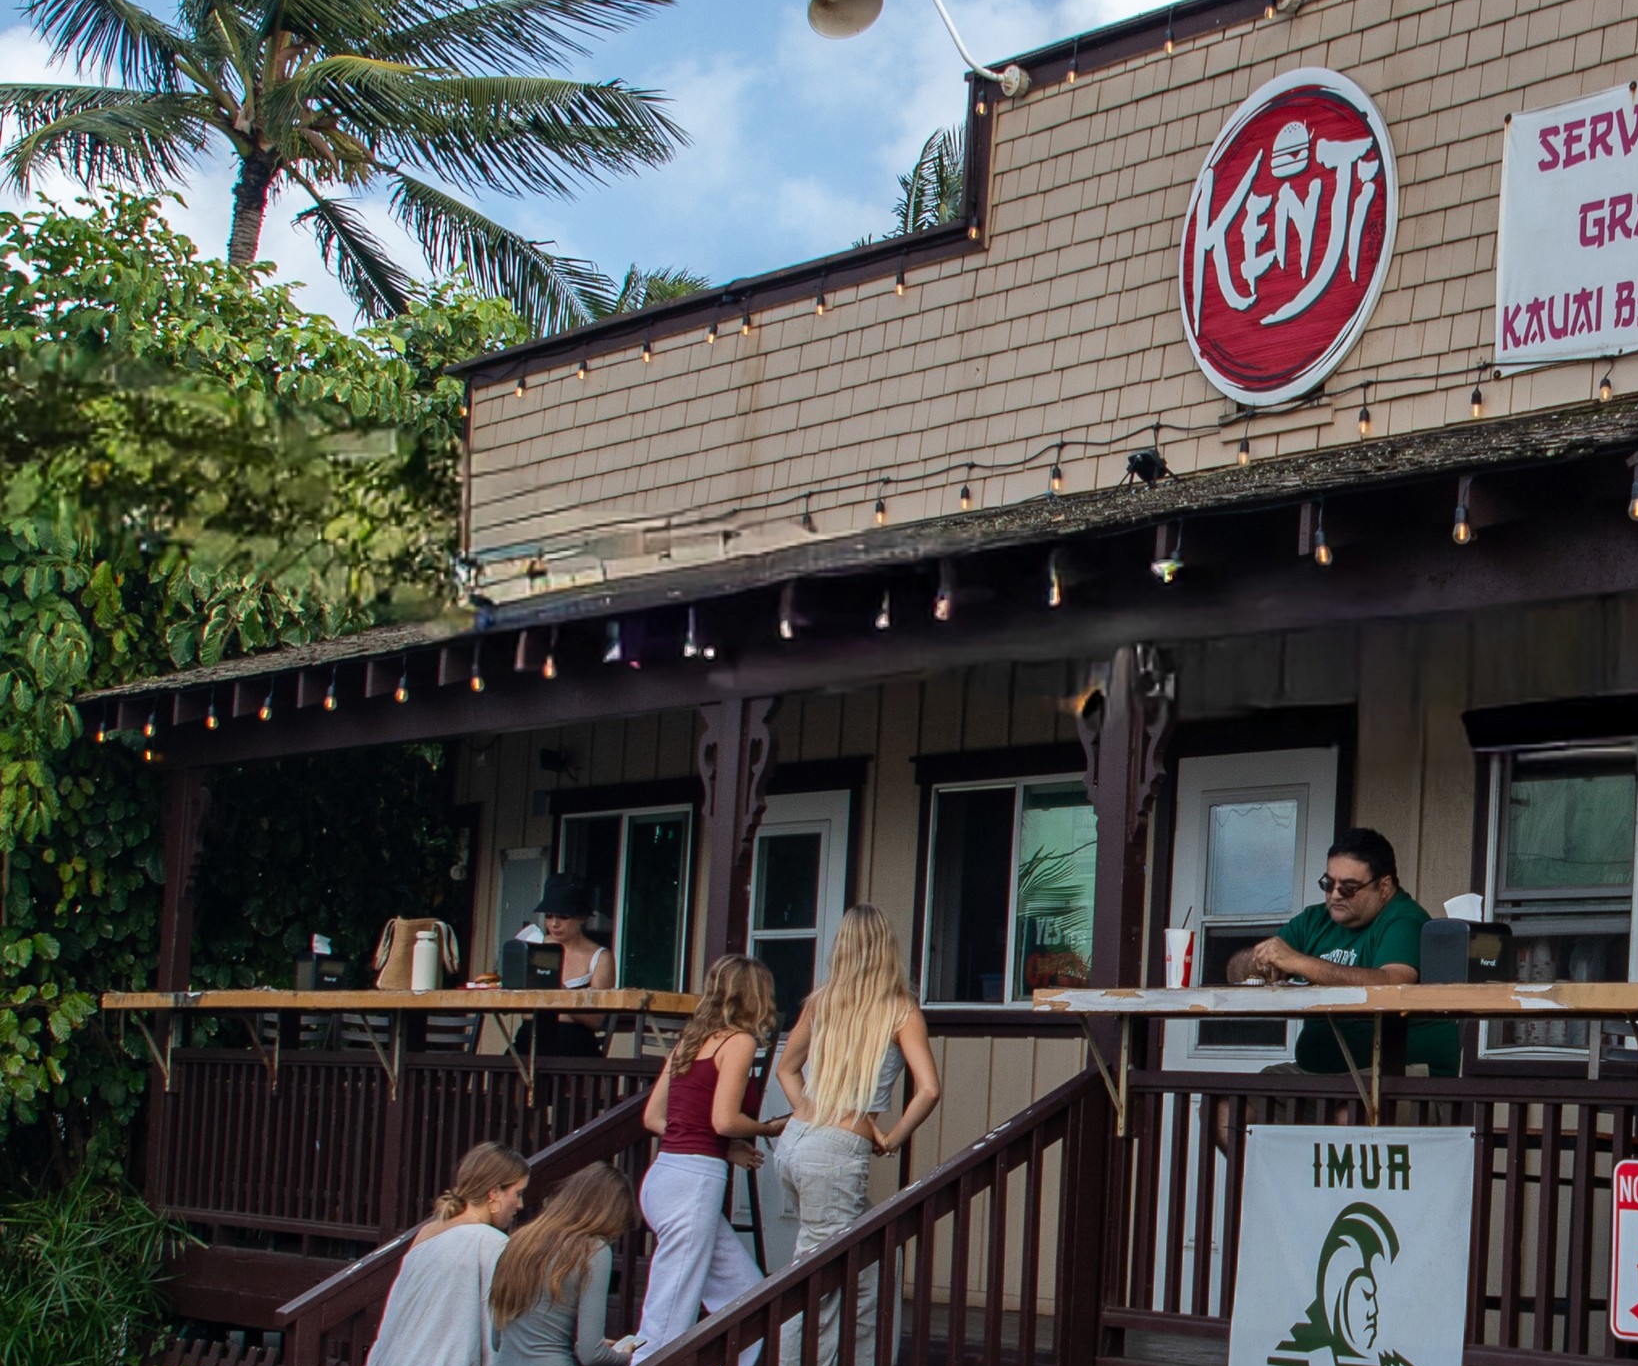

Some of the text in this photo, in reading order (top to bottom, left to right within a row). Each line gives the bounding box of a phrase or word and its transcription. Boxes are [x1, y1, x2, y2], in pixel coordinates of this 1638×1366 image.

[1501, 285, 1603, 352] KAUAI
[1035, 916, 1062, 945] YES
[1312, 1142, 1411, 1191] IMUA
